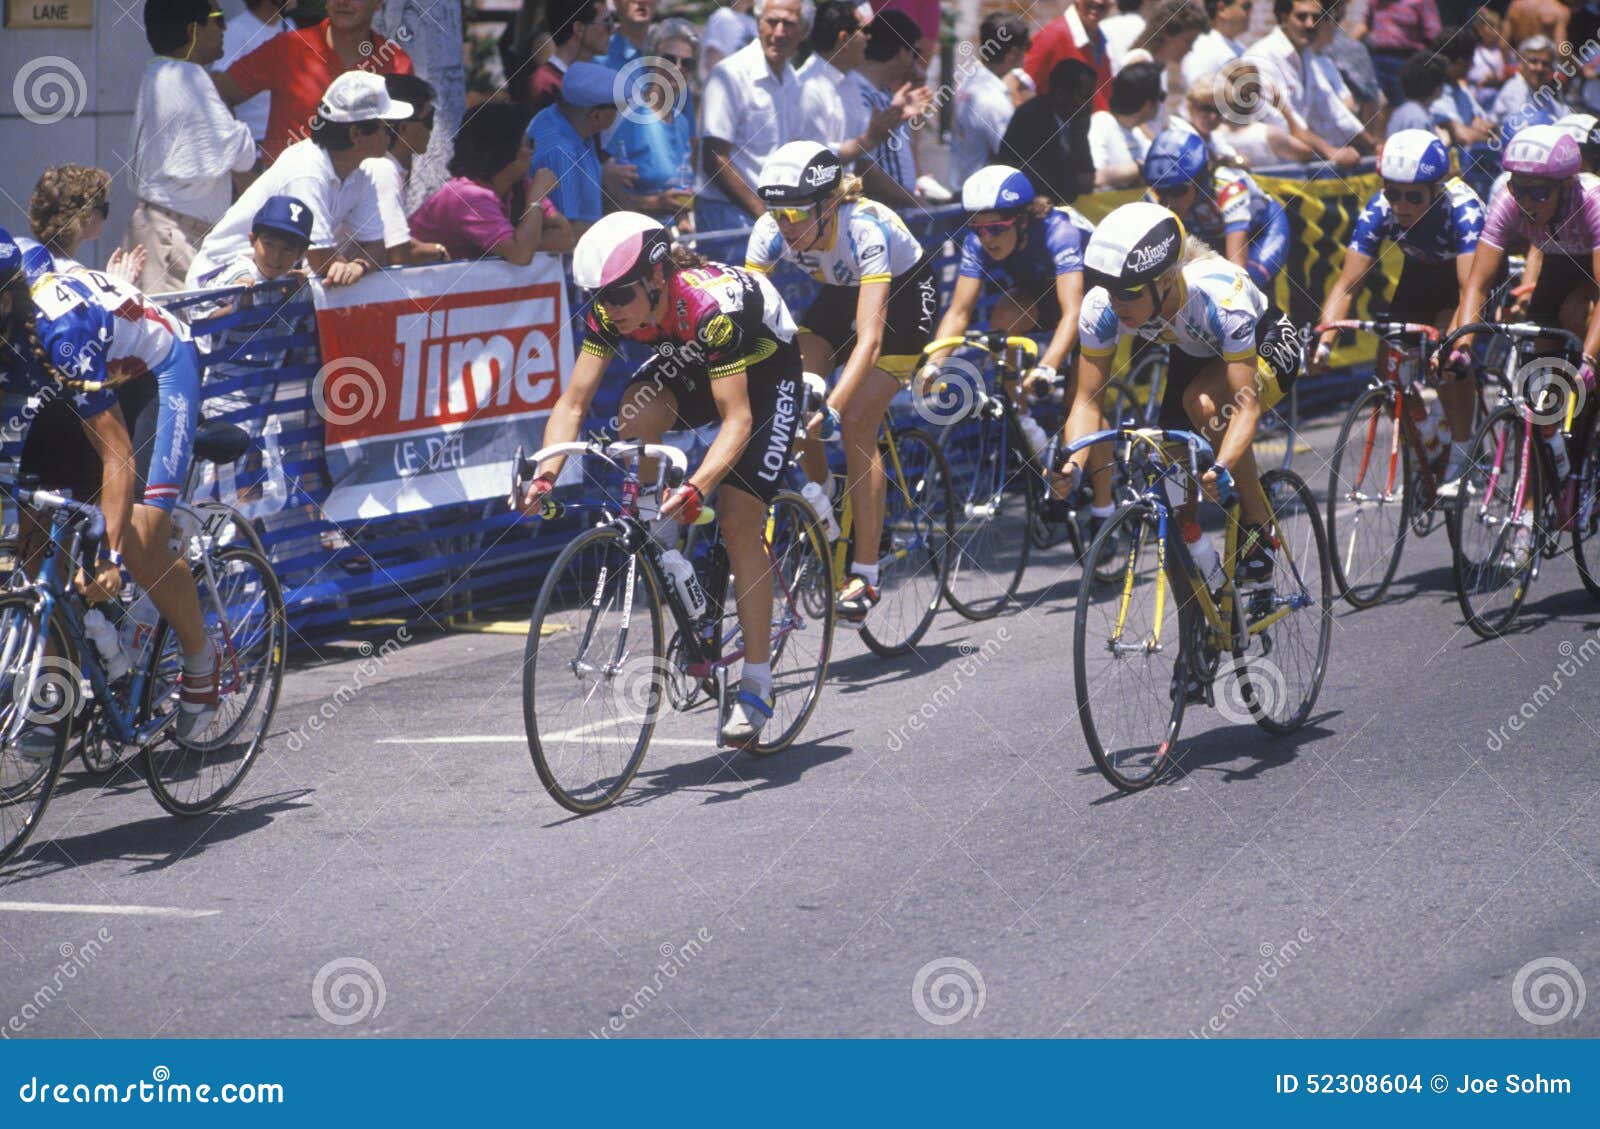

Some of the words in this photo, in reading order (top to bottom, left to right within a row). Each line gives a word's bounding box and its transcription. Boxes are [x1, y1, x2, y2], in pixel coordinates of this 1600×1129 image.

[32, 5, 69, 20] LANE
[289, 203, 303, 222] Y
[395, 297, 556, 422] Time
[757, 379, 796, 482] LOWREY'S
[394, 441, 419, 476] LE
[201, 513, 227, 536] 47
